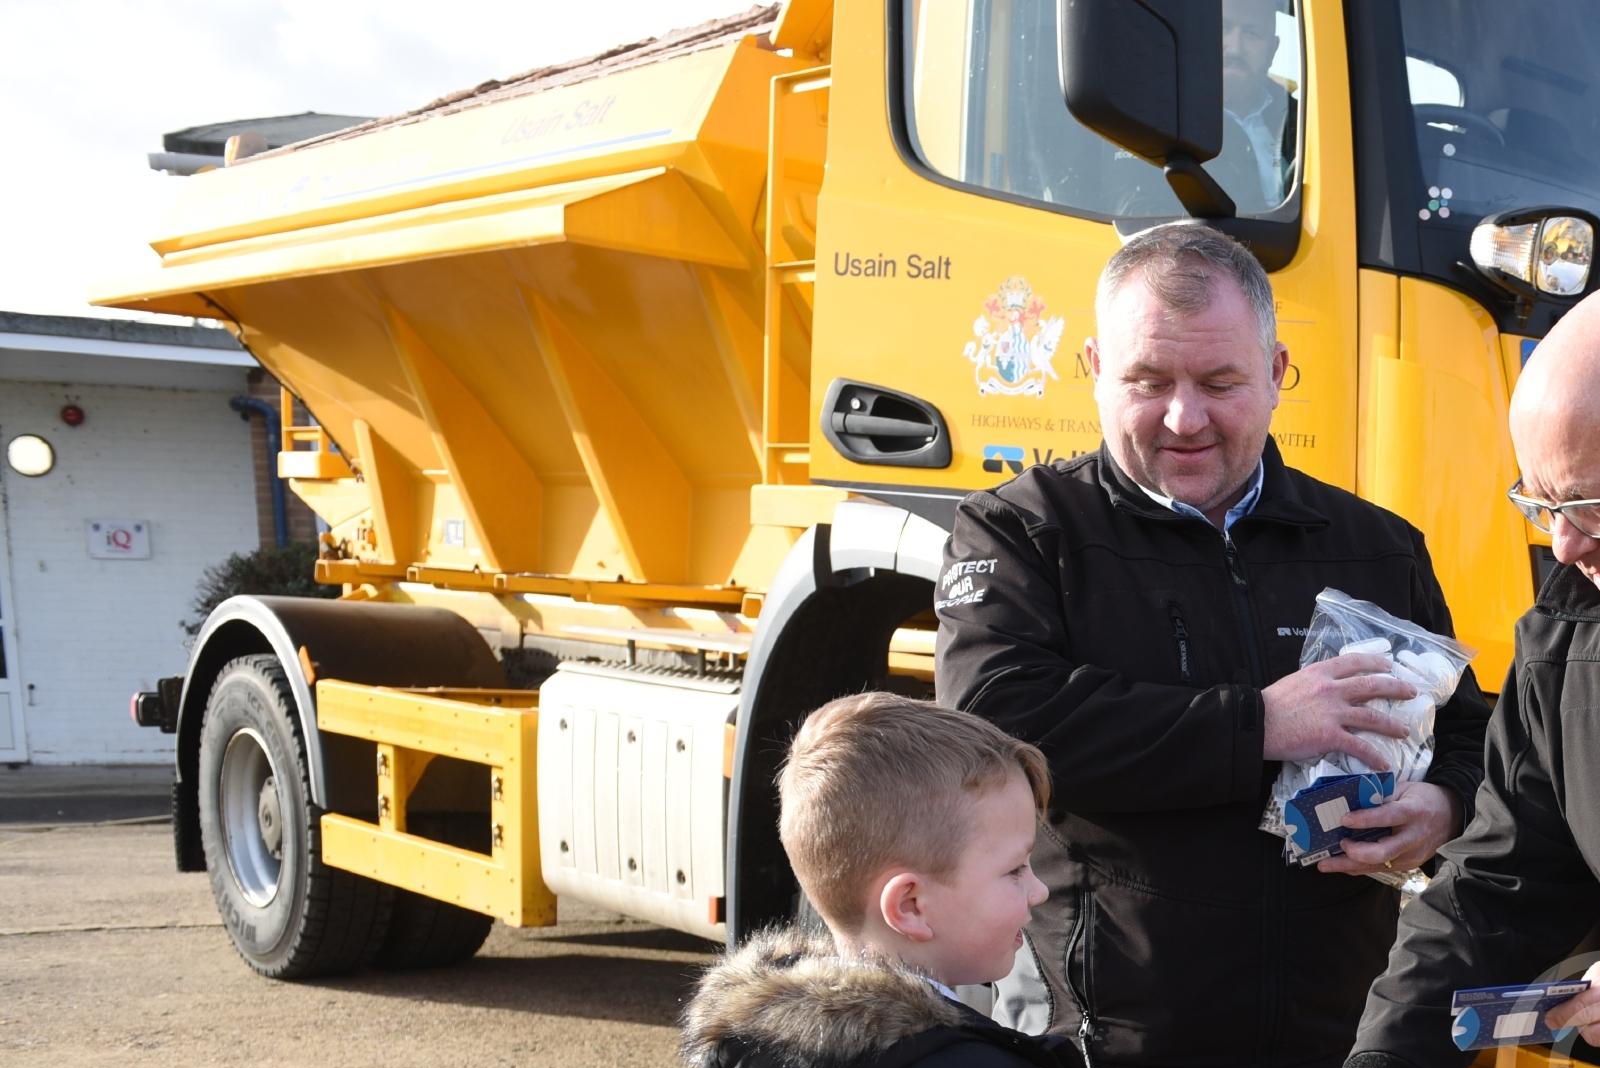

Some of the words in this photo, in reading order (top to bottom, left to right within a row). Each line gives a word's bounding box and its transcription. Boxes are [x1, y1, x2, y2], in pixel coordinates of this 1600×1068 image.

[834, 251, 897, 278] Usain
[906, 253, 952, 280] Salt
[971, 413, 1042, 431] HIGHWAYS
[1044, 418, 1055, 431] &
[1273, 432, 1317, 449] WITH
